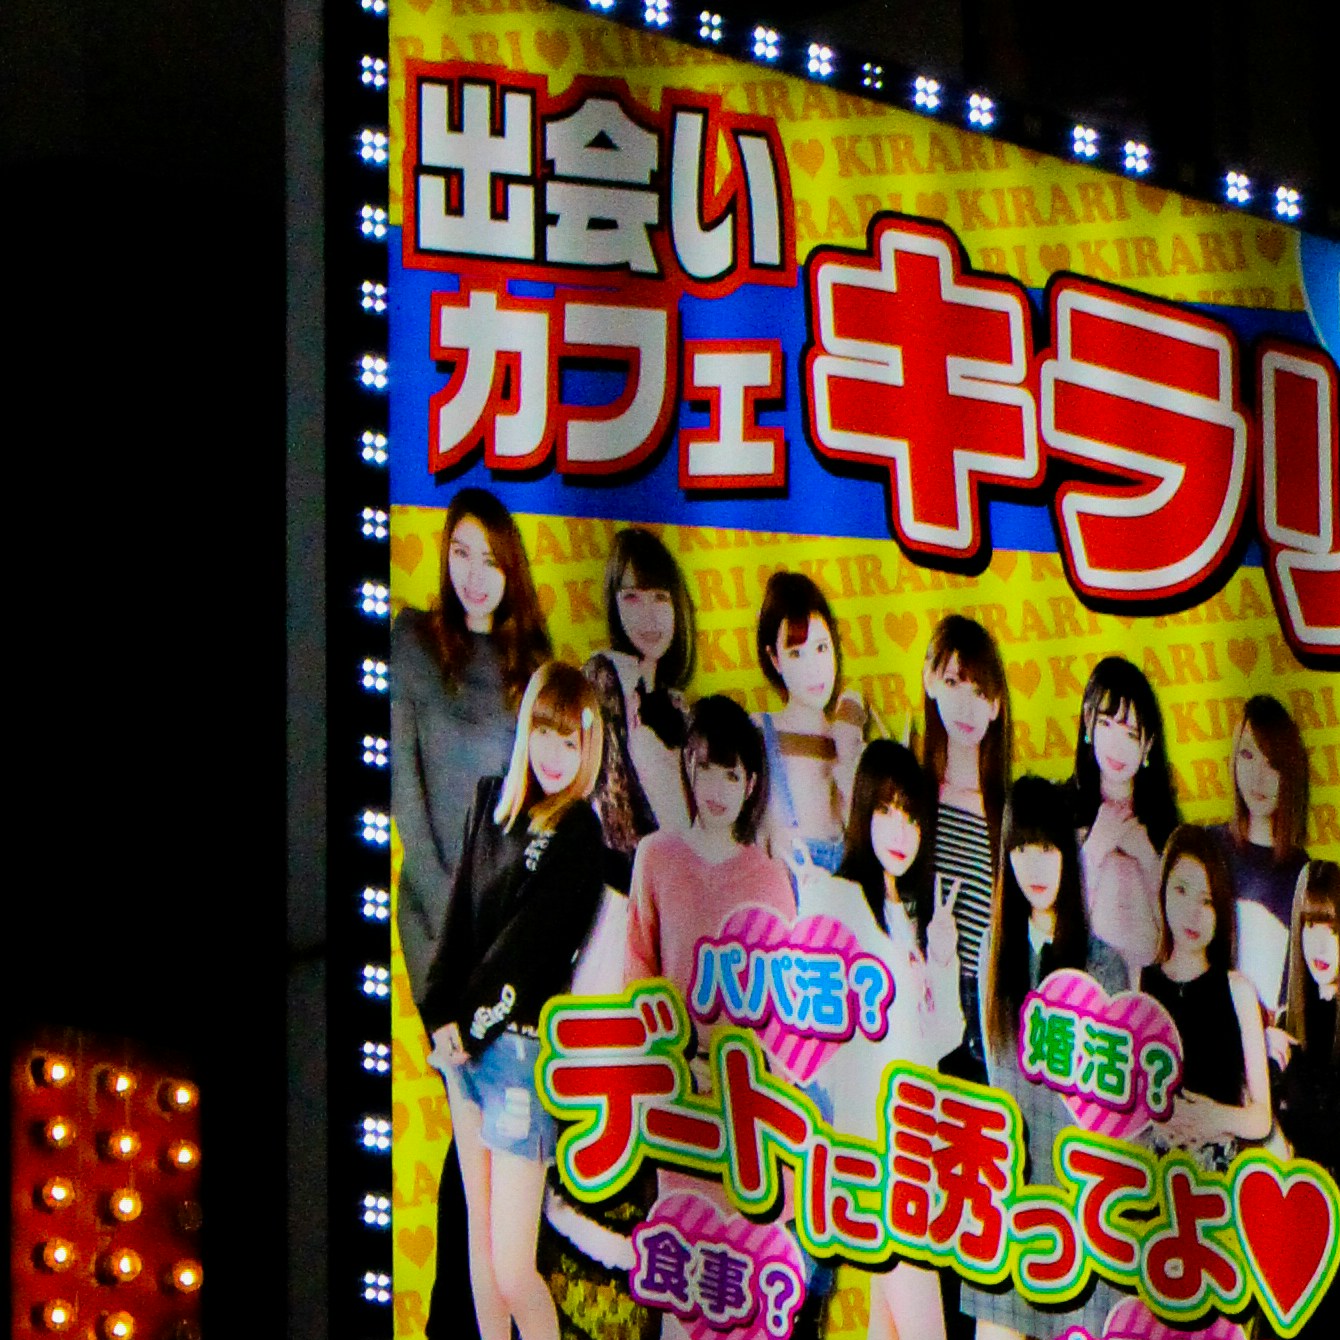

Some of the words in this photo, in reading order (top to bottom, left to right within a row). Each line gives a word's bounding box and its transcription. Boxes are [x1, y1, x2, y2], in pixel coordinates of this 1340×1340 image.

[415, 77, 786, 284] 出会い
[436, 287, 780, 482] カフェ
[692, 940, 890, 1036] パパ活？
[1022, 1001, 1180, 1118] 婚活？
[546, 994, 1246, 1306] デートに誘ってよ
[633, 1230, 802, 1337] 食事？
